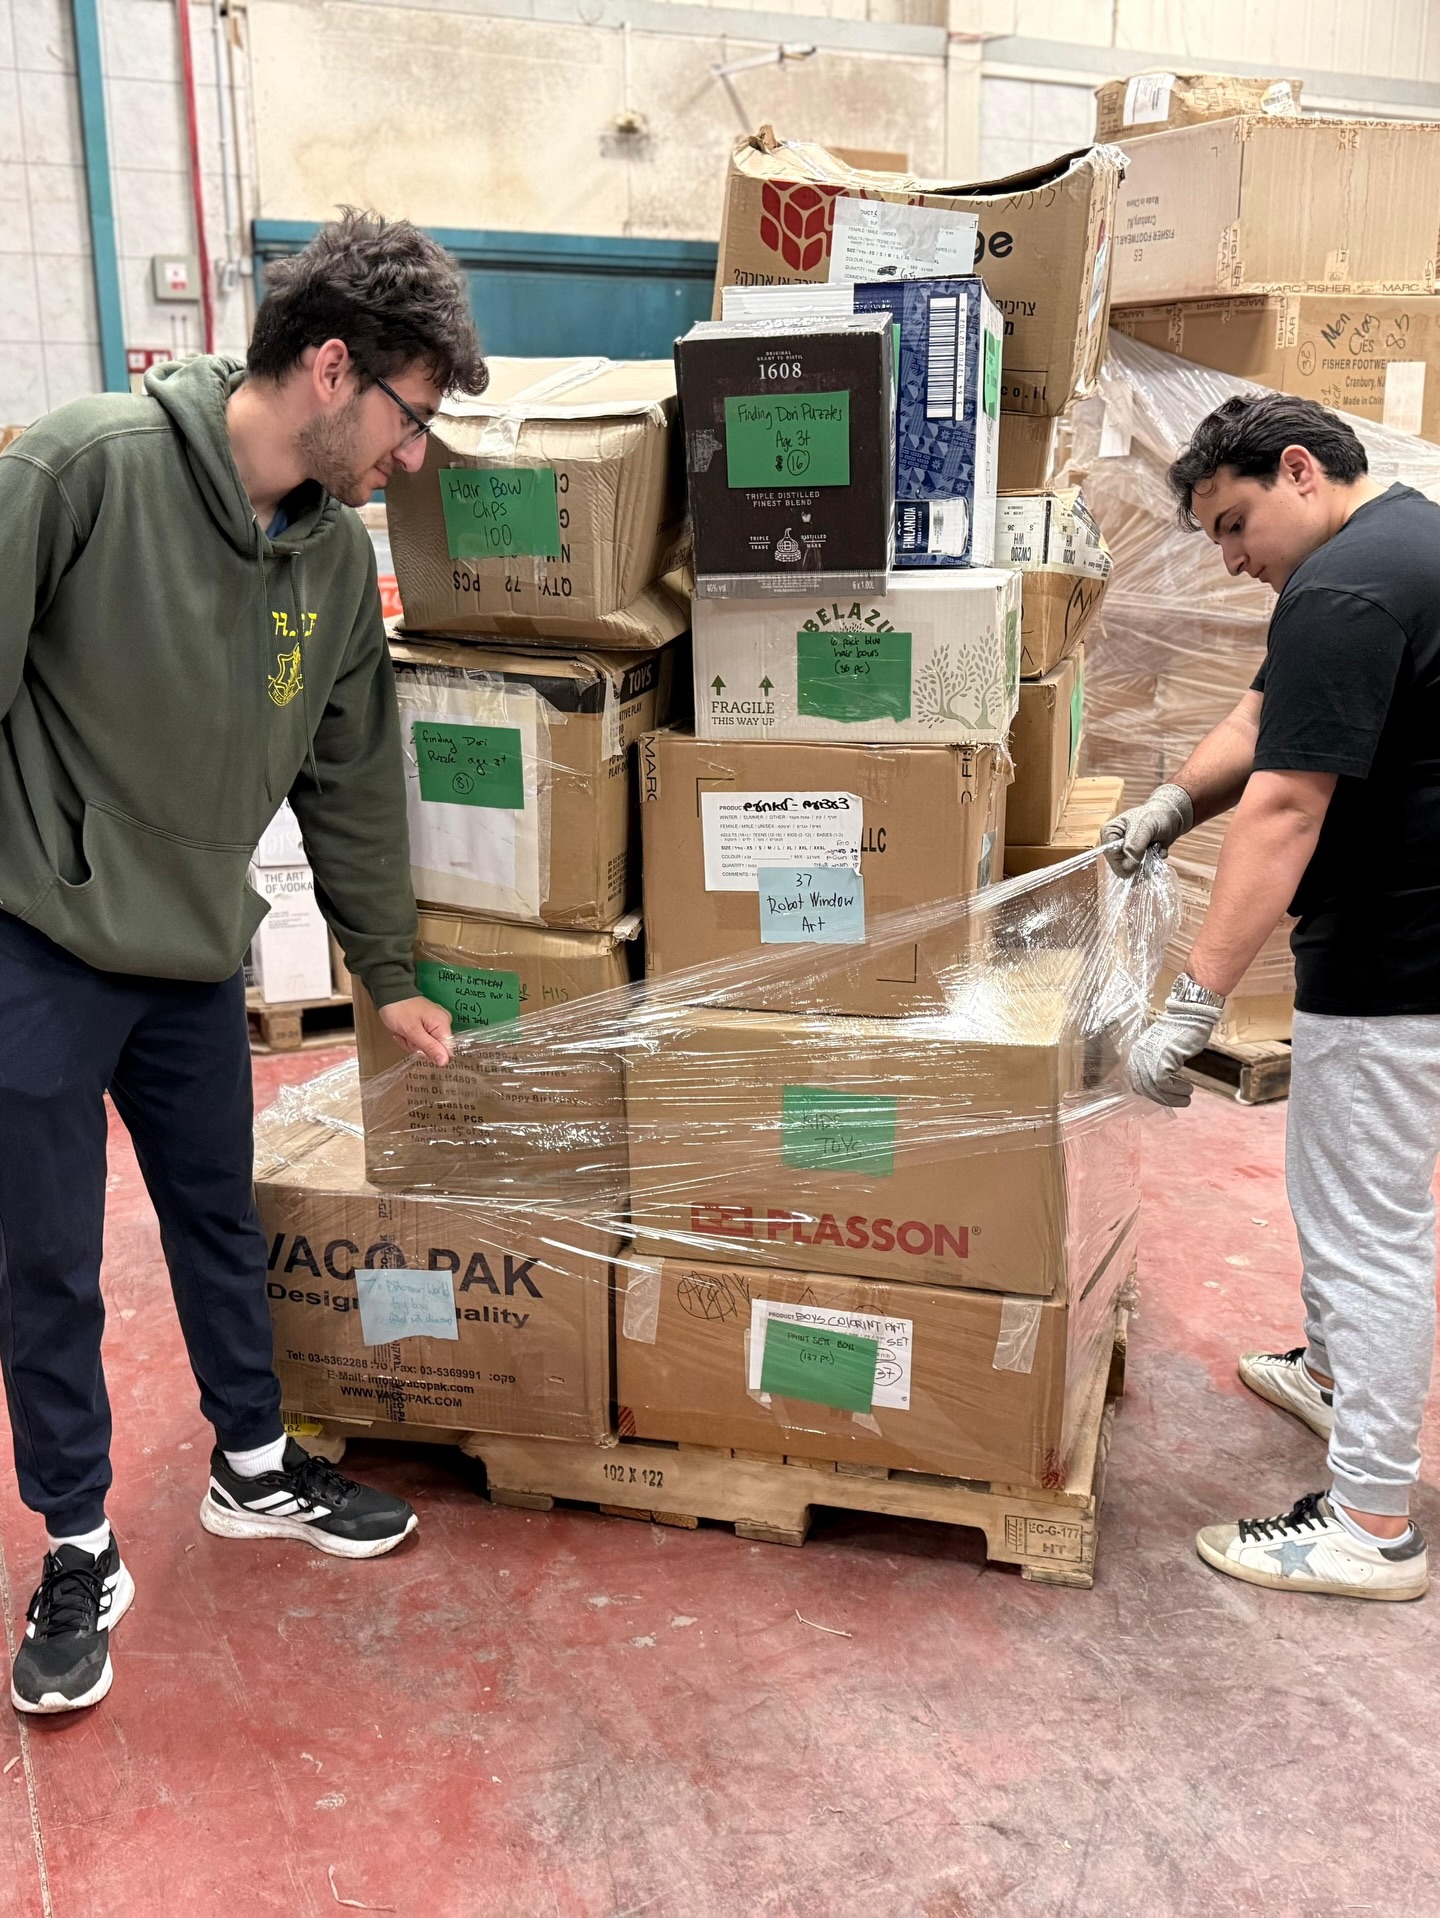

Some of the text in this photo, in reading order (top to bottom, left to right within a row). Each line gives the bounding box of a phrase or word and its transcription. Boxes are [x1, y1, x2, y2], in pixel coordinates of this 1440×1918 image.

[1152, 229, 1175, 241] FISHER
[1134, 248, 1143, 262] ES
[1306, 284, 1351, 293] FISHER
[1382, 283, 1420, 292] MARC
[1321, 312, 1351, 350] Men
[1362, 339, 1375, 353] ES
[758, 362, 802, 380] 1608
[1322, 358, 1394, 370] FISHER FOOTWE
[1345, 375, 1376, 391] Cranbury,
[1342, 395, 1384, 406] Made in Chin
[737, 403, 773, 430] Finding
[800, 402, 843, 421] Puzzles
[775, 430, 793, 453] Age
[448, 477, 522, 500] Hair Bow
[745, 491, 820, 500] TRIPLE DISTILLED
[472, 500, 508, 523] Clips
[753, 499, 812, 508] FINEST BLEND
[483, 524, 513, 548] 100
[903, 507, 916, 549] FINLANDIA
[1013, 533, 1024, 545] WH
[1010, 546, 1032, 562] CW200
[453, 570, 573, 596] QTY: 72 PCS
[865, 635, 881, 646] blue
[833, 647, 853, 658] hair
[629, 663, 652, 695] TOYS
[631, 701, 643, 718] PLAY
[710, 701, 775, 715] FRAGILE
[711, 717, 775, 727] THIS WAY UP
[264, 871, 305, 884] THE ART
[795, 873, 813, 888] 37
[265, 881, 314, 894] OF VODKA
[767, 891, 854, 915] Robot Window
[801, 915, 826, 933] Art
[438, 970, 463, 984] HAPPY
[406, 1083, 429, 1093] Item
[438, 1113, 456, 1121] 144
[463, 1115, 484, 1123] PCS
[814, 1136, 862, 1158] TOYS
[766, 1208, 969, 1259] PLASSON
[427, 1247, 544, 1299] PAK
[455, 1306, 531, 1329] ality
[886, 1337, 910, 1347] SET
[286, 1349, 306, 1362] Tel:
[308, 1353, 368, 1369] 03-5362288
[420, 1365, 481, 1380] 03-5369991
[340, 1385, 463, 1409] WWW.VACOPAK.COM
[602, 1463, 664, 1489] 102 X 122
[1042, 1542, 1067, 1555] HT
